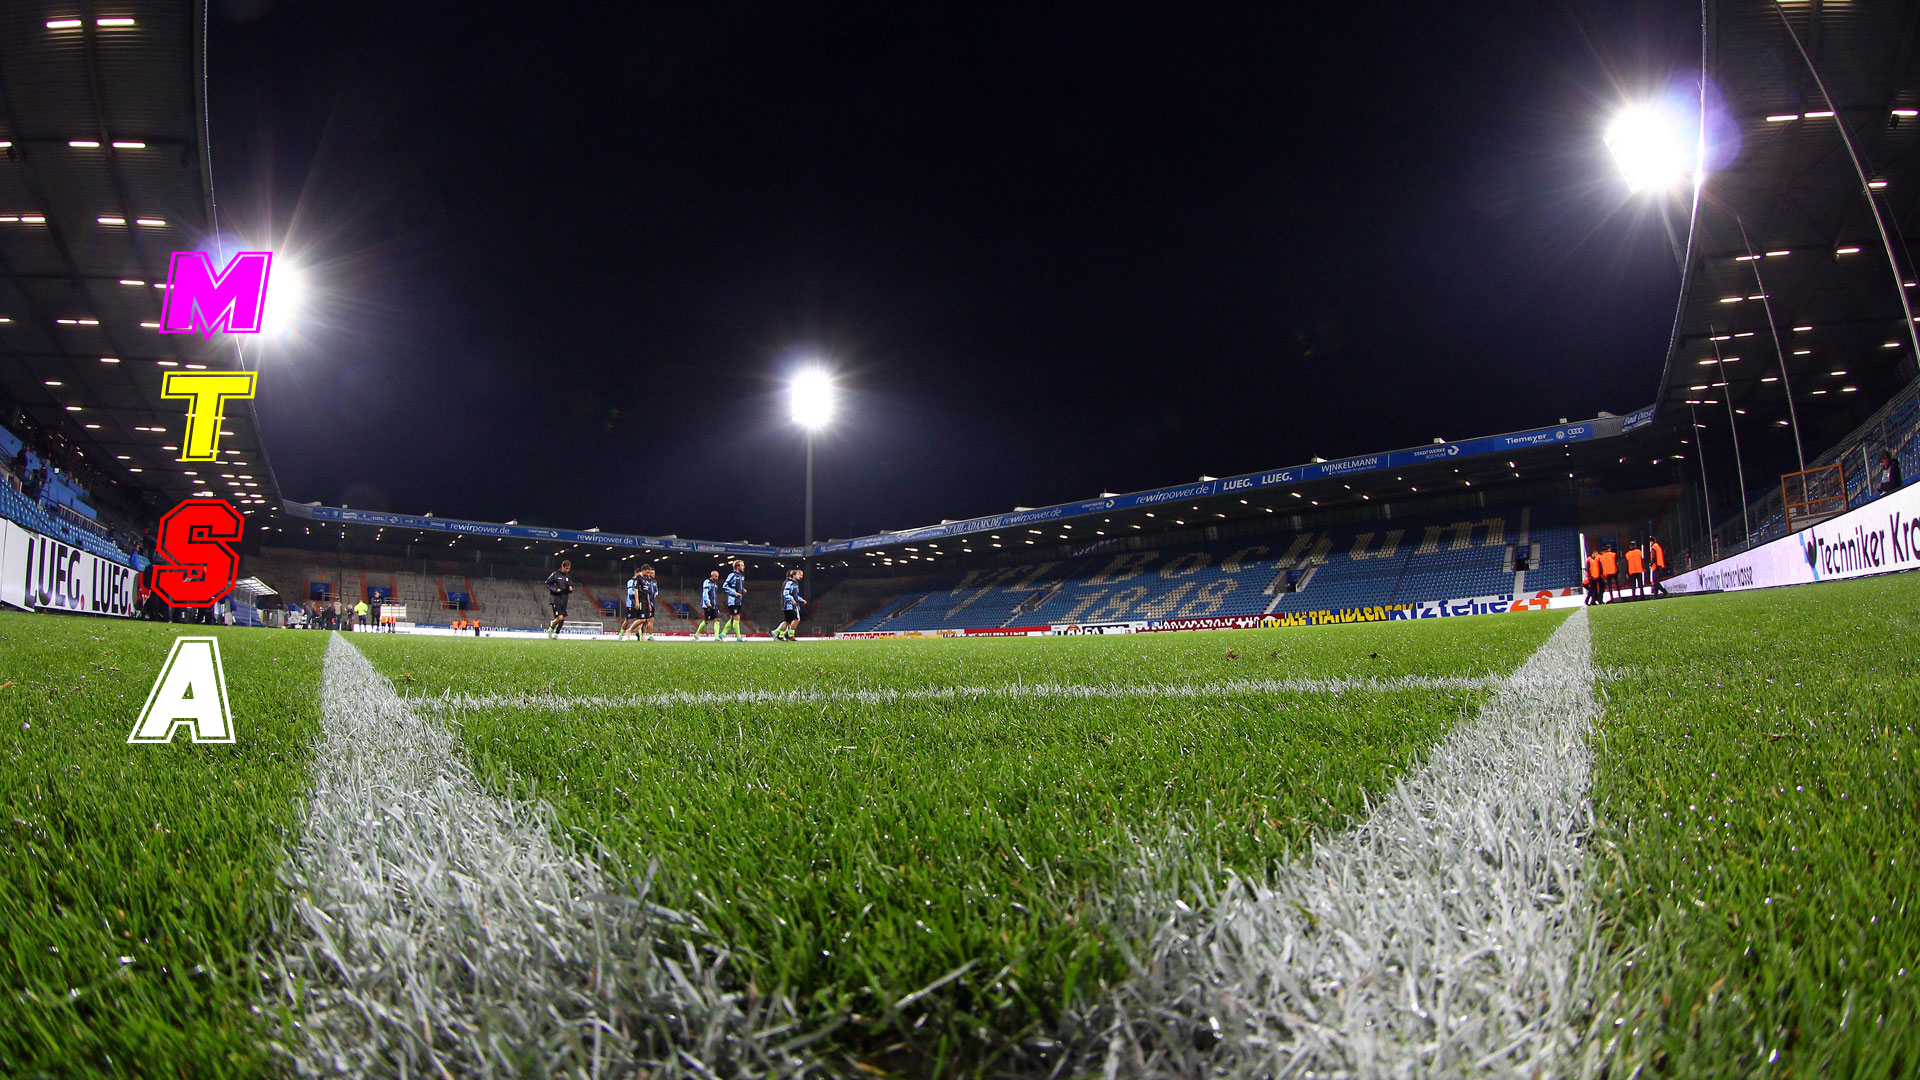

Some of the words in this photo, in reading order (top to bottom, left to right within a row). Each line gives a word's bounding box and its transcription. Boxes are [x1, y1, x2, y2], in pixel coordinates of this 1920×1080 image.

[1505, 433, 1547, 444] Tiemeyer
[1321, 457, 1378, 474] WINKELMANN
[1135, 484, 1209, 504] rewirpower.de
[1223, 478, 1253, 491] LUEG.
[1261, 472, 1293, 485] LUEG.
[1002, 508, 1062, 525] rewirpower.de
[450, 523, 510, 535] rewirpower.de
[577, 533, 633, 545] rewirpower.de
[1817, 524, 1885, 575] Techniker
[24, 537, 85, 610] LUEG.
[92, 557, 132, 617] LUEG.
